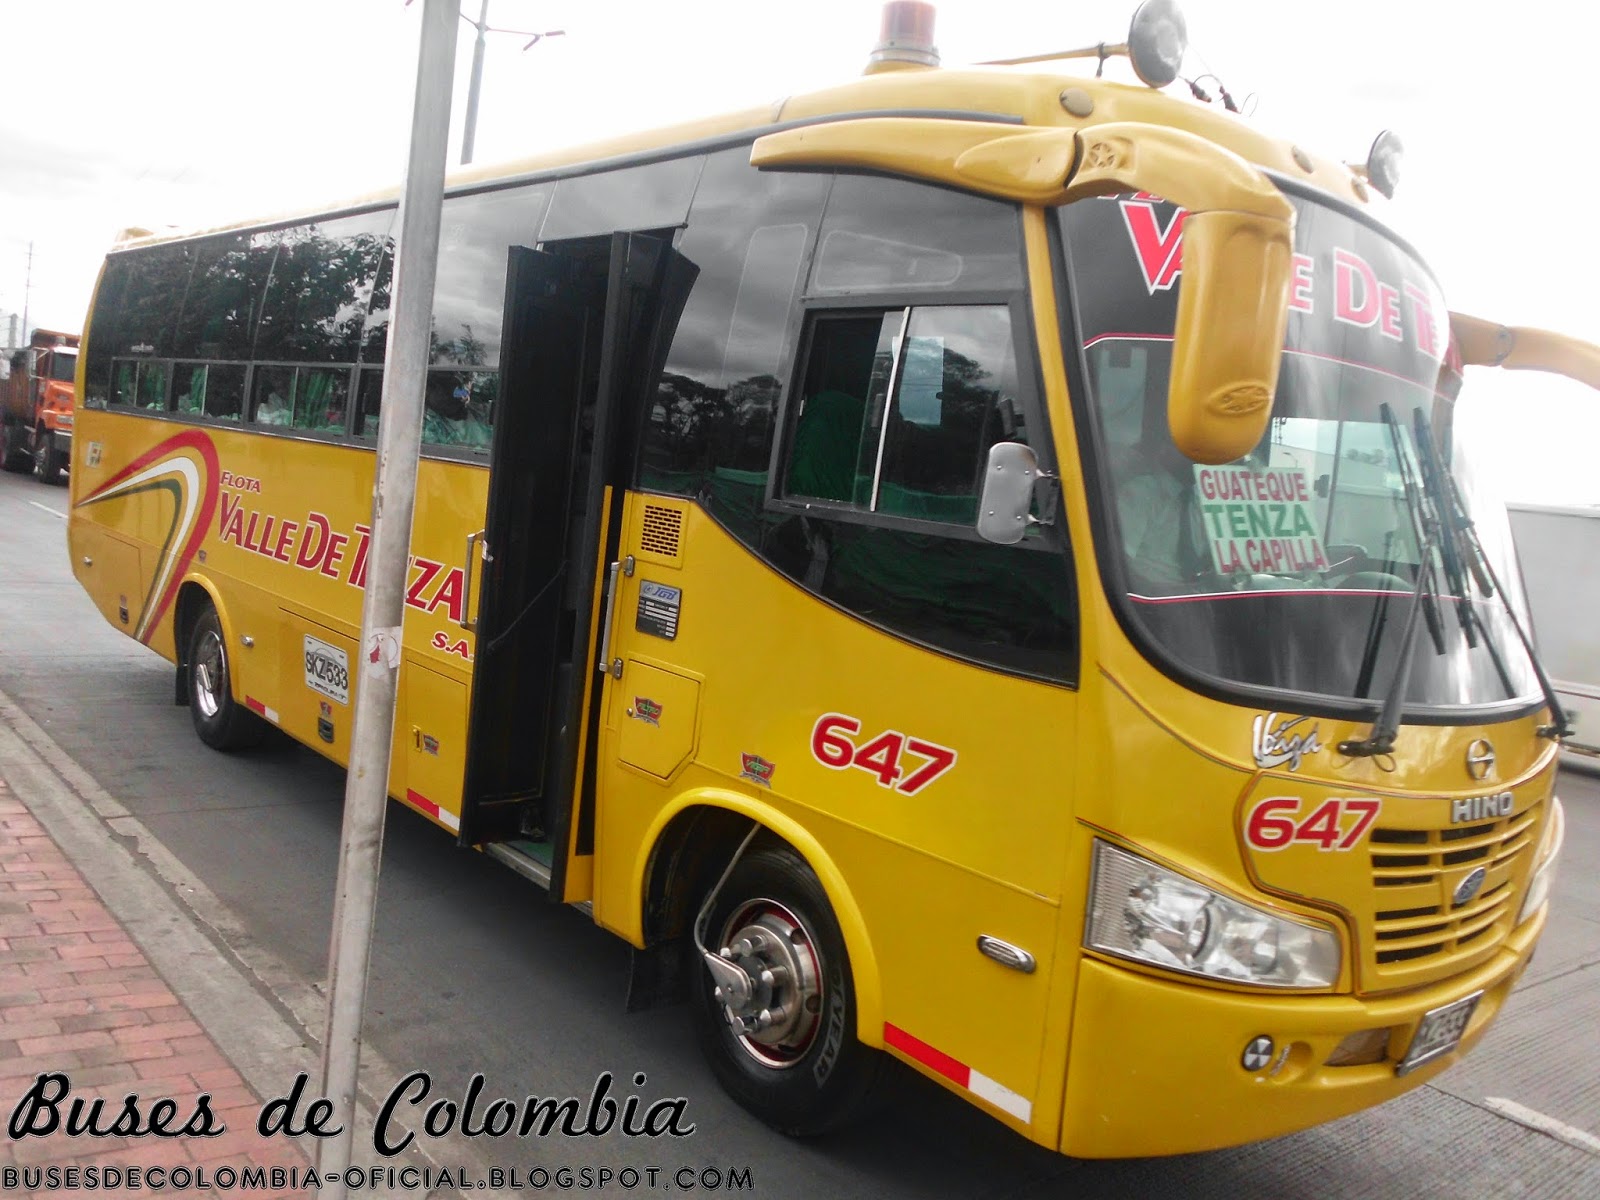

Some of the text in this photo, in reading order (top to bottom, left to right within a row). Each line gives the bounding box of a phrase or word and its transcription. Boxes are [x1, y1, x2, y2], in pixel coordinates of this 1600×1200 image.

[220, 471, 261, 493] FLOTA
[1200, 469, 1309, 502] GUATEQUE
[1203, 504, 1317, 538] TENZA
[219, 491, 465, 624] VALLE DE TZA
[1214, 539, 1329, 573] LA CAPILLA
[305, 651, 348, 691] SKZ533
[810, 712, 959, 797] 647
[1244, 796, 1384, 853] 647
[1452, 791, 1515, 824] HINO
